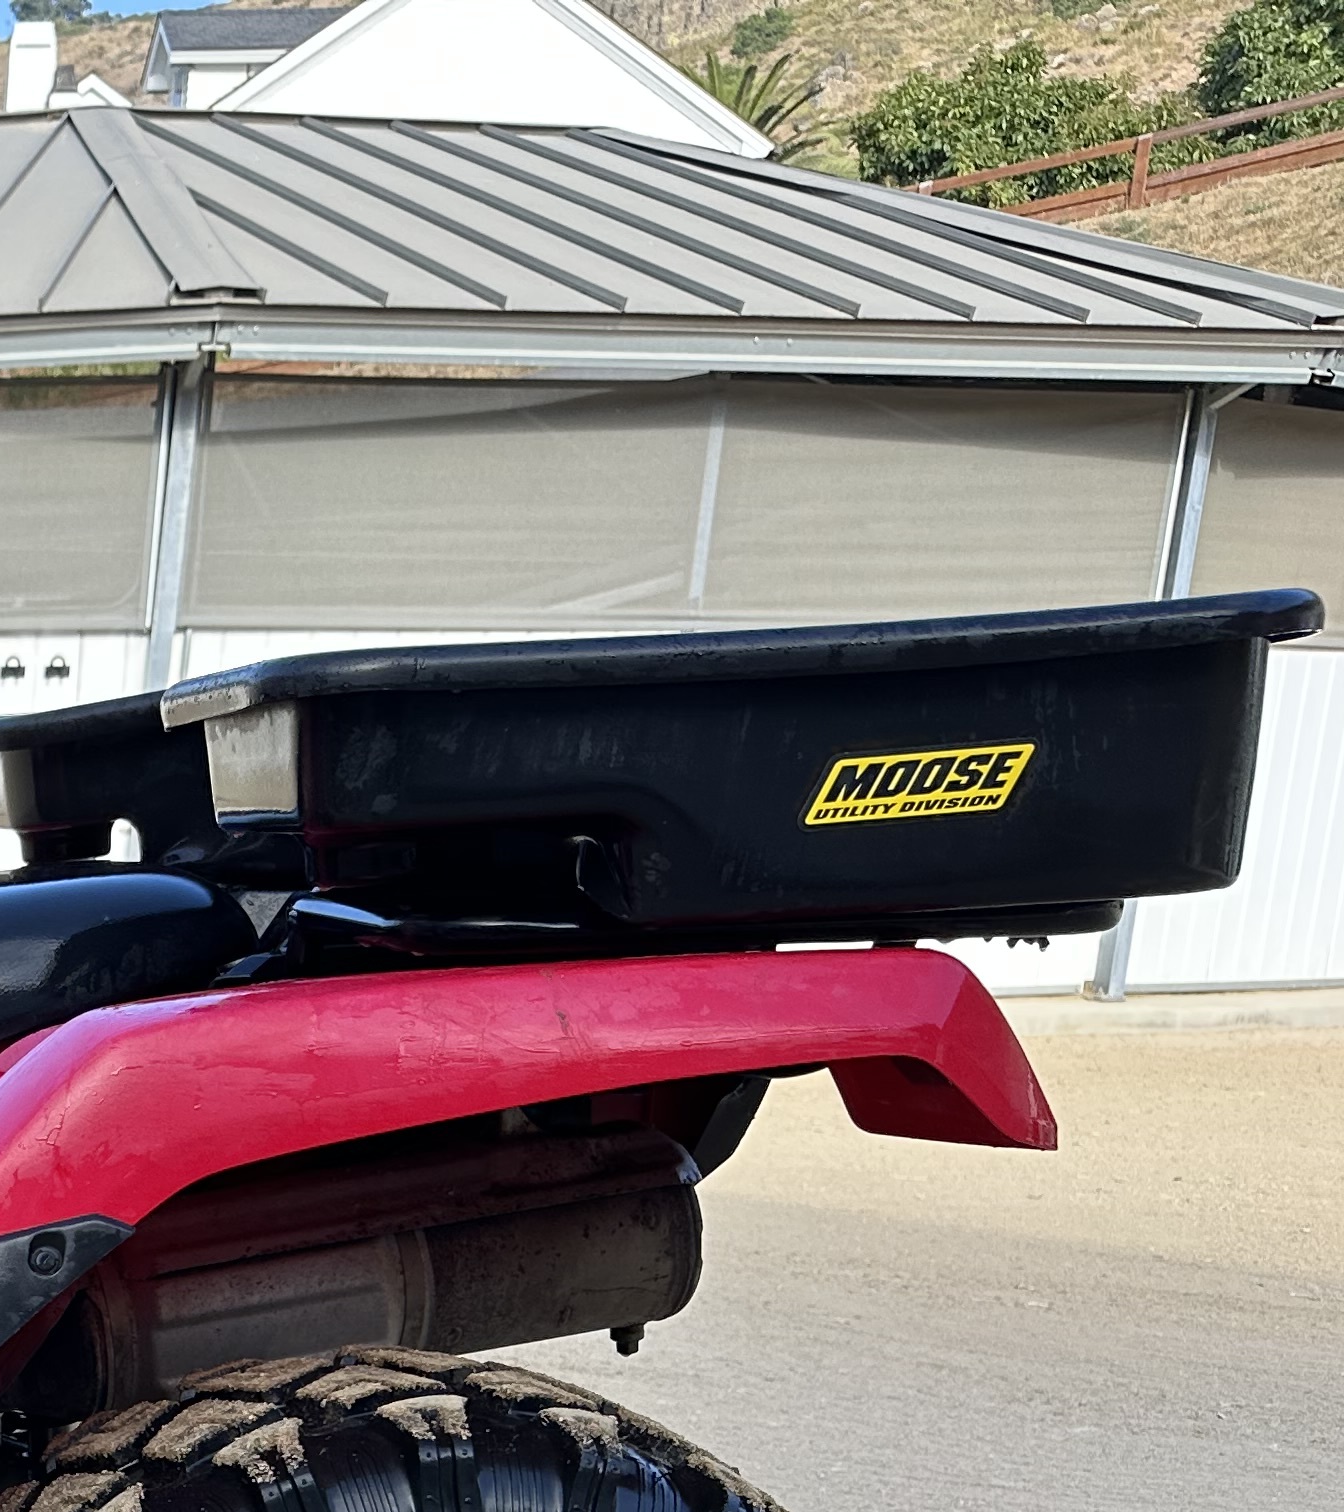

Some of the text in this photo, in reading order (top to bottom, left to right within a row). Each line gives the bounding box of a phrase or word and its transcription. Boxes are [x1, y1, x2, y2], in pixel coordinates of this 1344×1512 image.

[822, 750, 1025, 804] MOOSE
[813, 793, 1003, 820] UTILITY DIVISION
